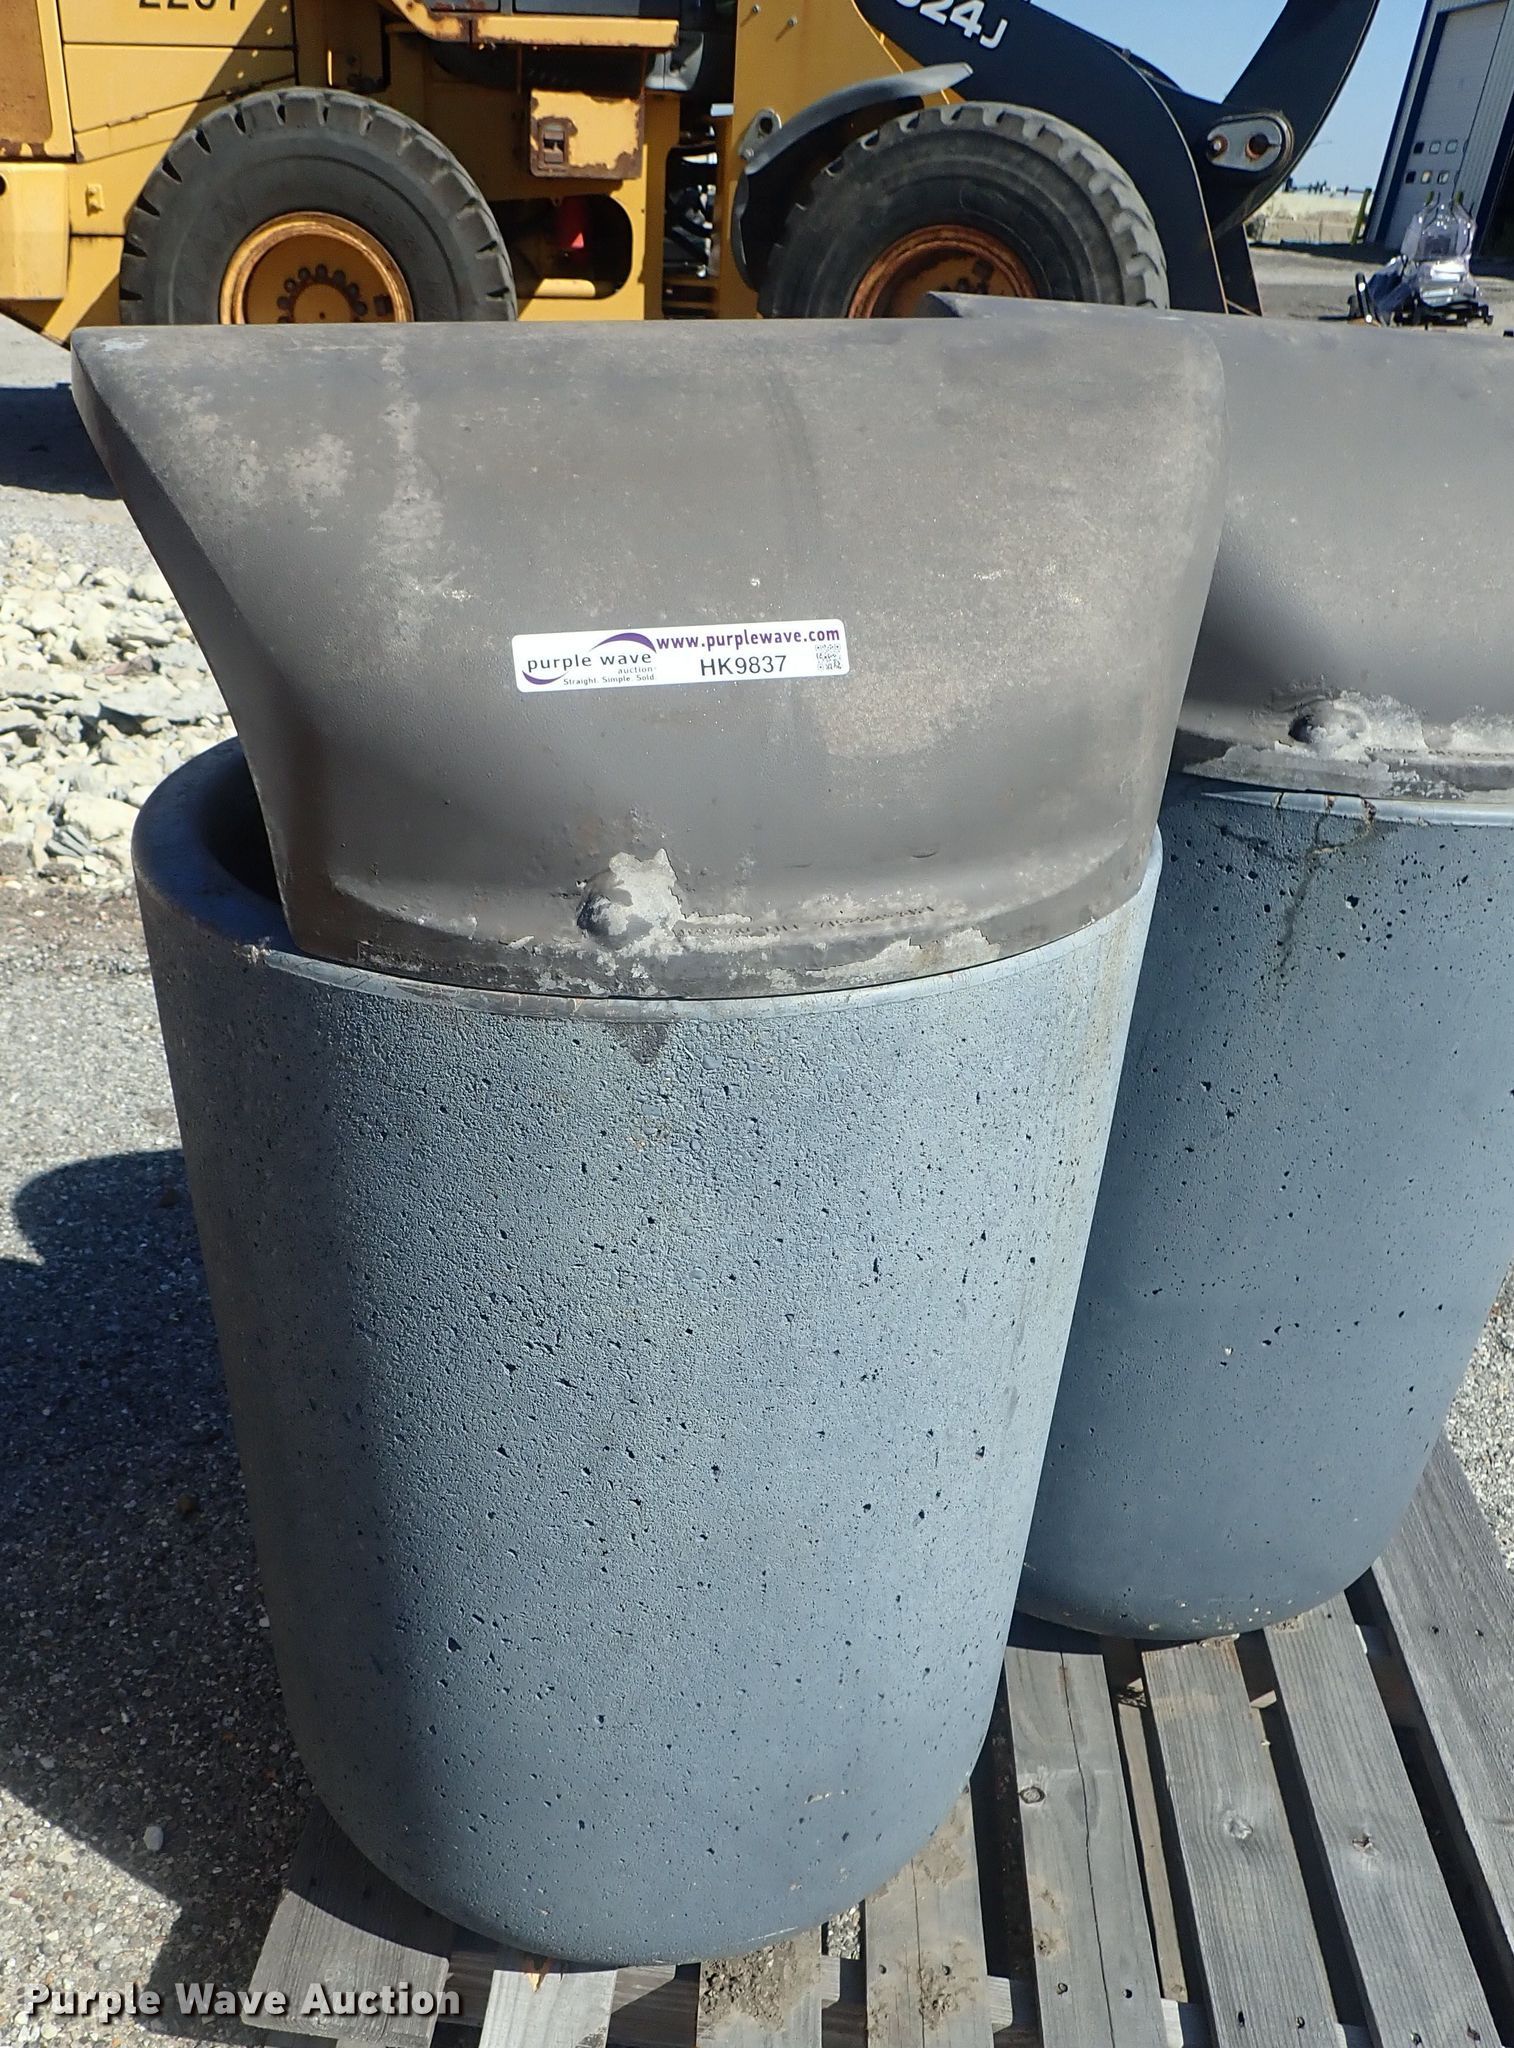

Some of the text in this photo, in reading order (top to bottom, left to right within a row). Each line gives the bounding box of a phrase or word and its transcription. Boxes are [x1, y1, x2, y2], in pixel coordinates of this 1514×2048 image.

[896, 0, 1008, 48] 24J
[656, 629, 840, 652] www.purplewave.com
[527, 653, 652, 673] purple wave
[617, 666, 654, 675] auction
[700, 655, 787, 676] HK9837
